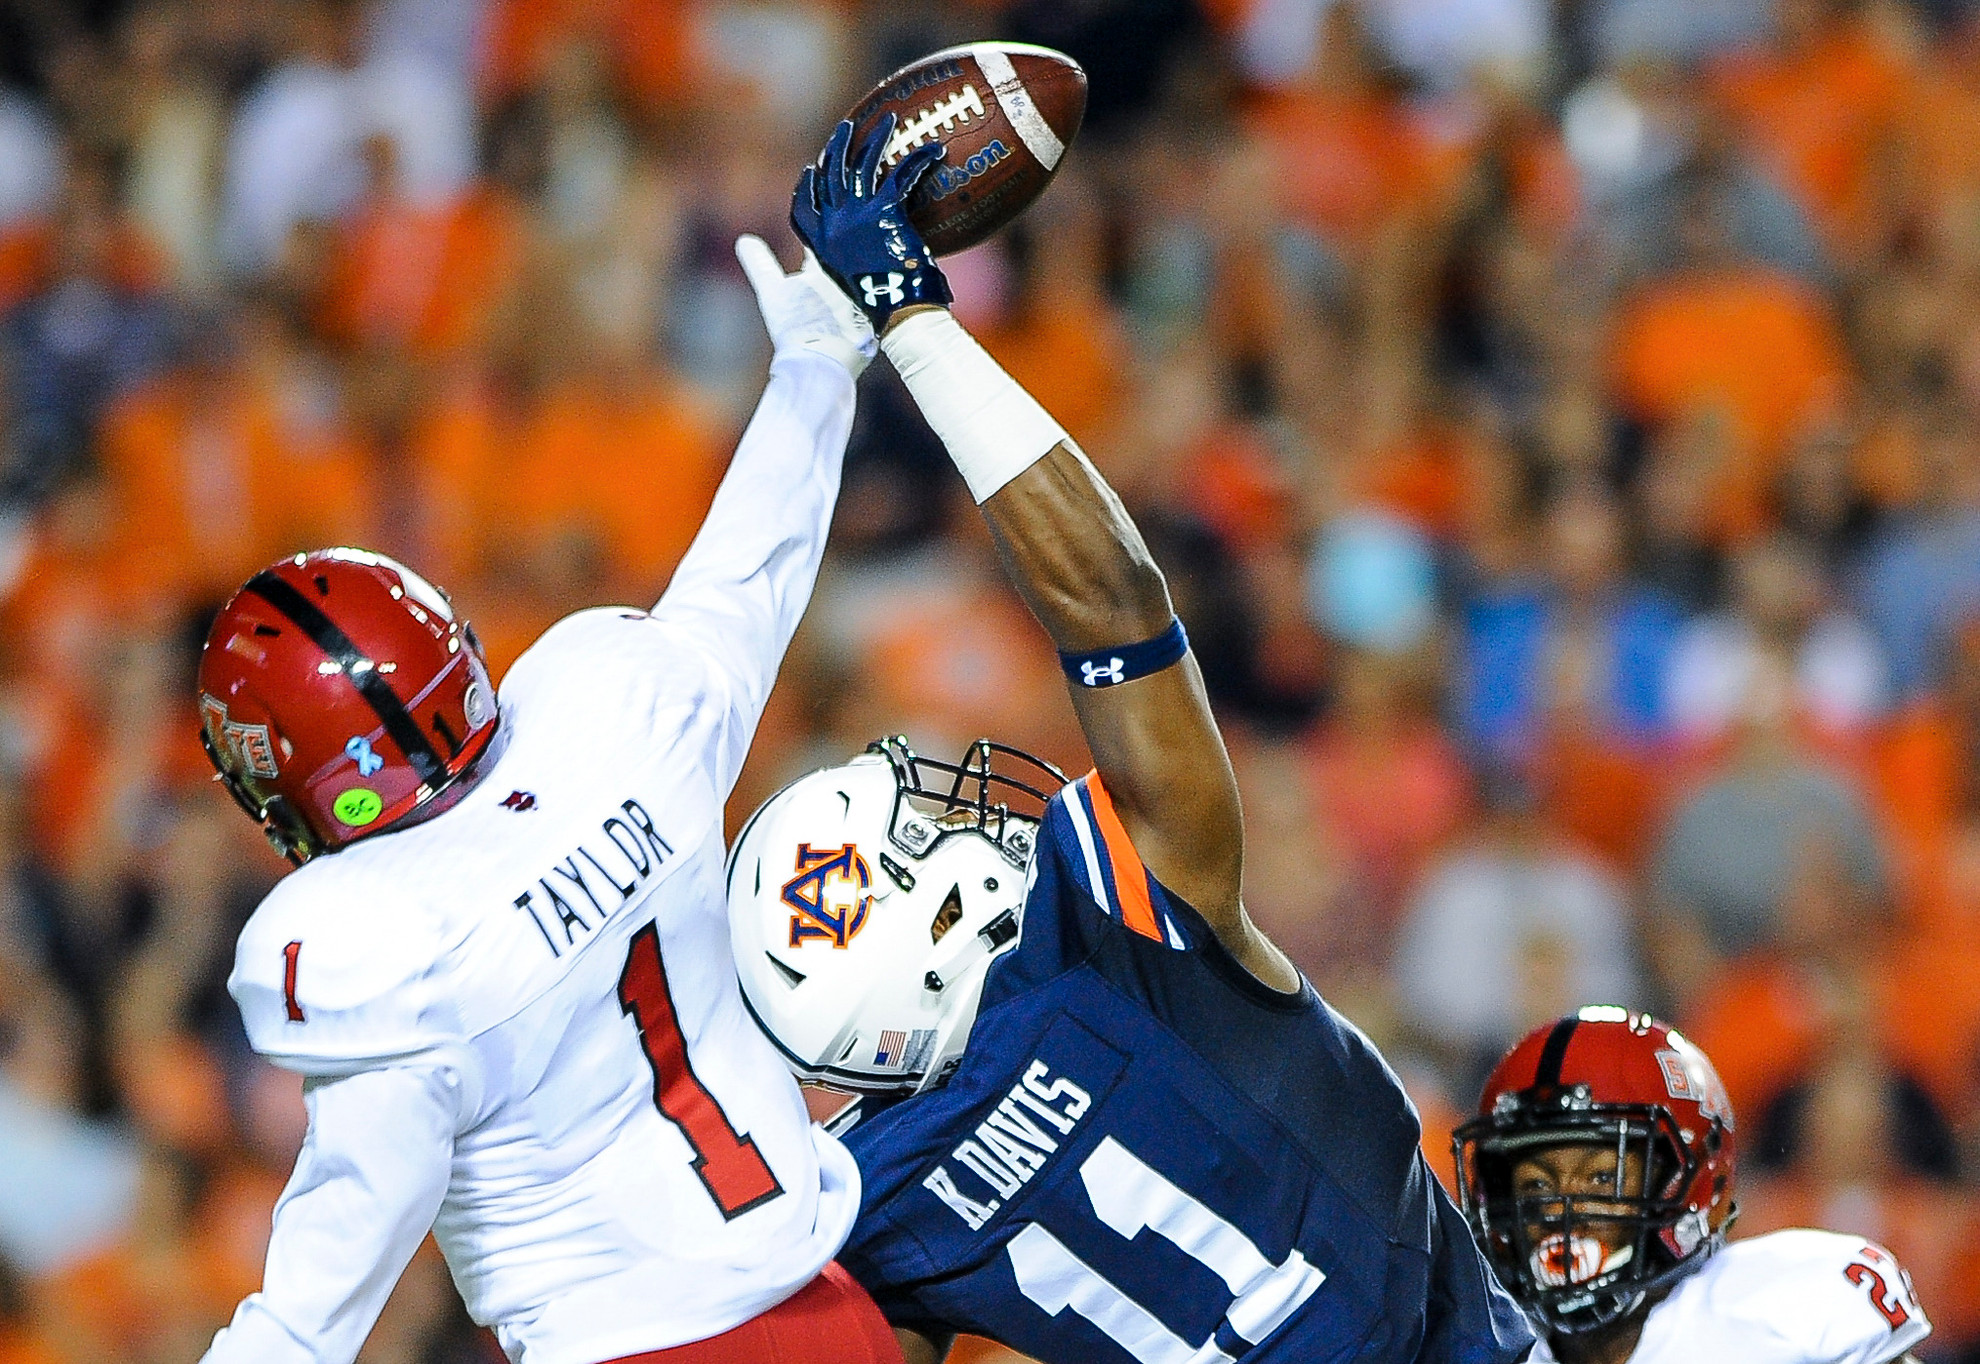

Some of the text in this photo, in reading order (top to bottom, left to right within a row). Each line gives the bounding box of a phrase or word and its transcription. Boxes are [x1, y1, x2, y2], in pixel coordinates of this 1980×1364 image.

[433, 711, 464, 757] 1
[512, 798, 675, 958] TAYLOR
[282, 940, 306, 1022] 1
[616, 917, 786, 1222] 1
[1006, 1134, 1326, 1364] 11
